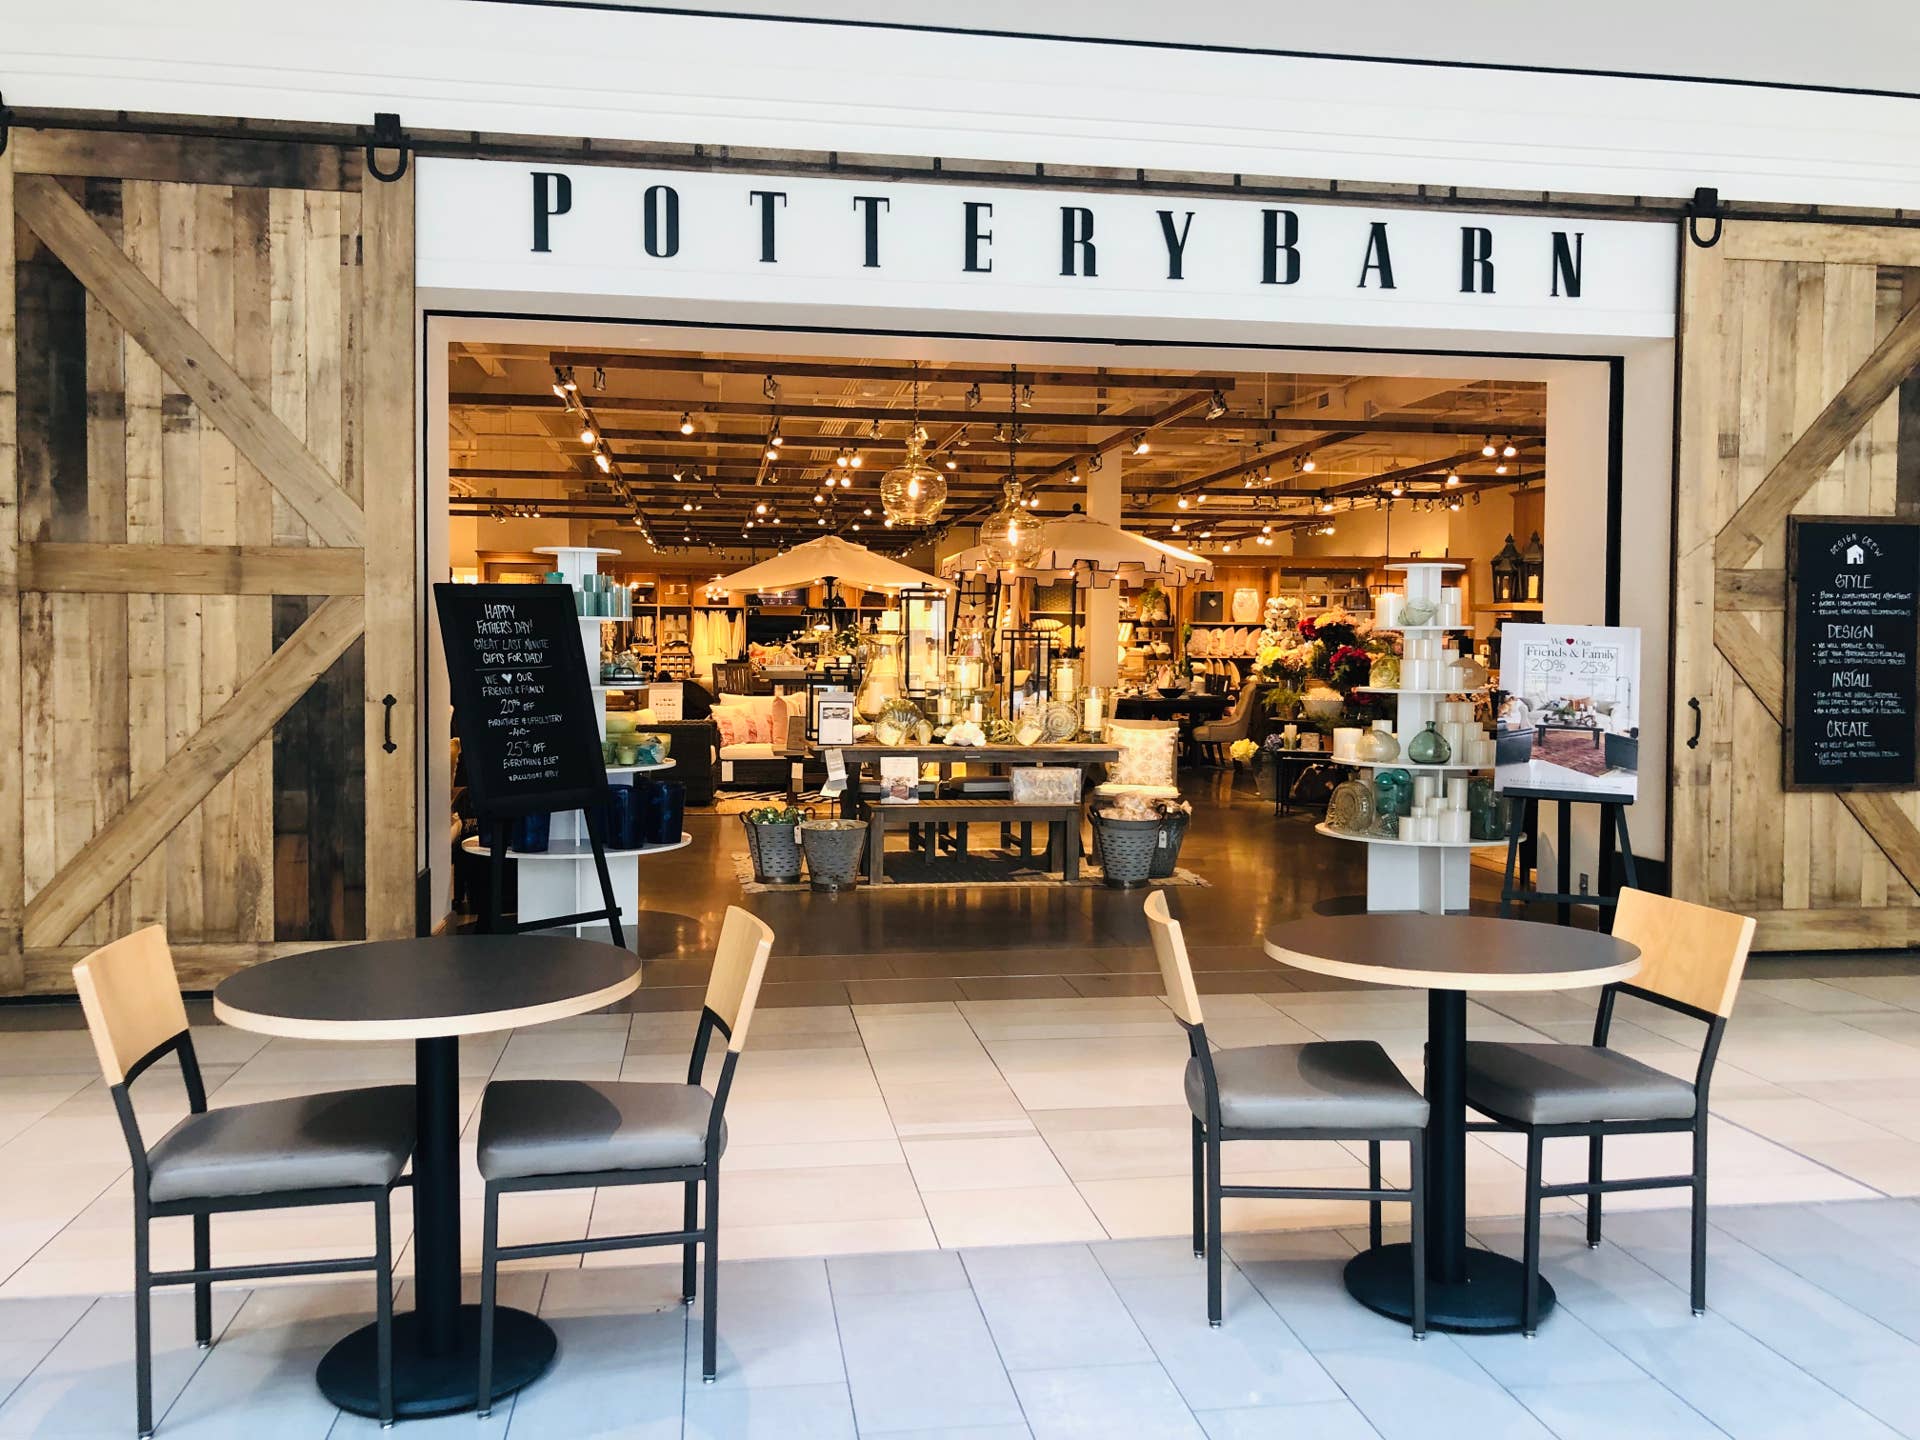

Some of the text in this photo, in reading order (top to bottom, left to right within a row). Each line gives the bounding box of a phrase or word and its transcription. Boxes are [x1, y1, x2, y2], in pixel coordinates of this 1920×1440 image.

[1830, 533, 1884, 557] DESIGN CREW
[1835, 573, 1873, 589] STYLE
[484, 603, 515, 619] HAPPY
[514, 619, 533, 634] DAY!
[1827, 624, 1873, 639] DESIGN
[473, 638, 550, 650] GREAT LAST MINUTE
[1550, 637, 1592, 647] We Our
[482, 652, 543, 665] GIFTS FOR DAD!
[1526, 646, 1615, 662] Friends & Family
[1531, 658, 1566, 672] 20%
[1580, 660, 1610, 674] 25%
[484, 671, 535, 685] WE OUR
[1832, 668, 1873, 688] INSTALL
[482, 686, 512, 697] FRIENDS
[521, 684, 545, 694] FAMILY
[500, 698, 535, 715] 20% OFF
[487, 717, 520, 728] FURNITURE
[527, 713, 563, 725] UPHOLSTERY
[1827, 720, 1872, 738] CREATE
[532, 742, 547, 754] OFF
[503, 758, 541, 769] EVERYTHING
